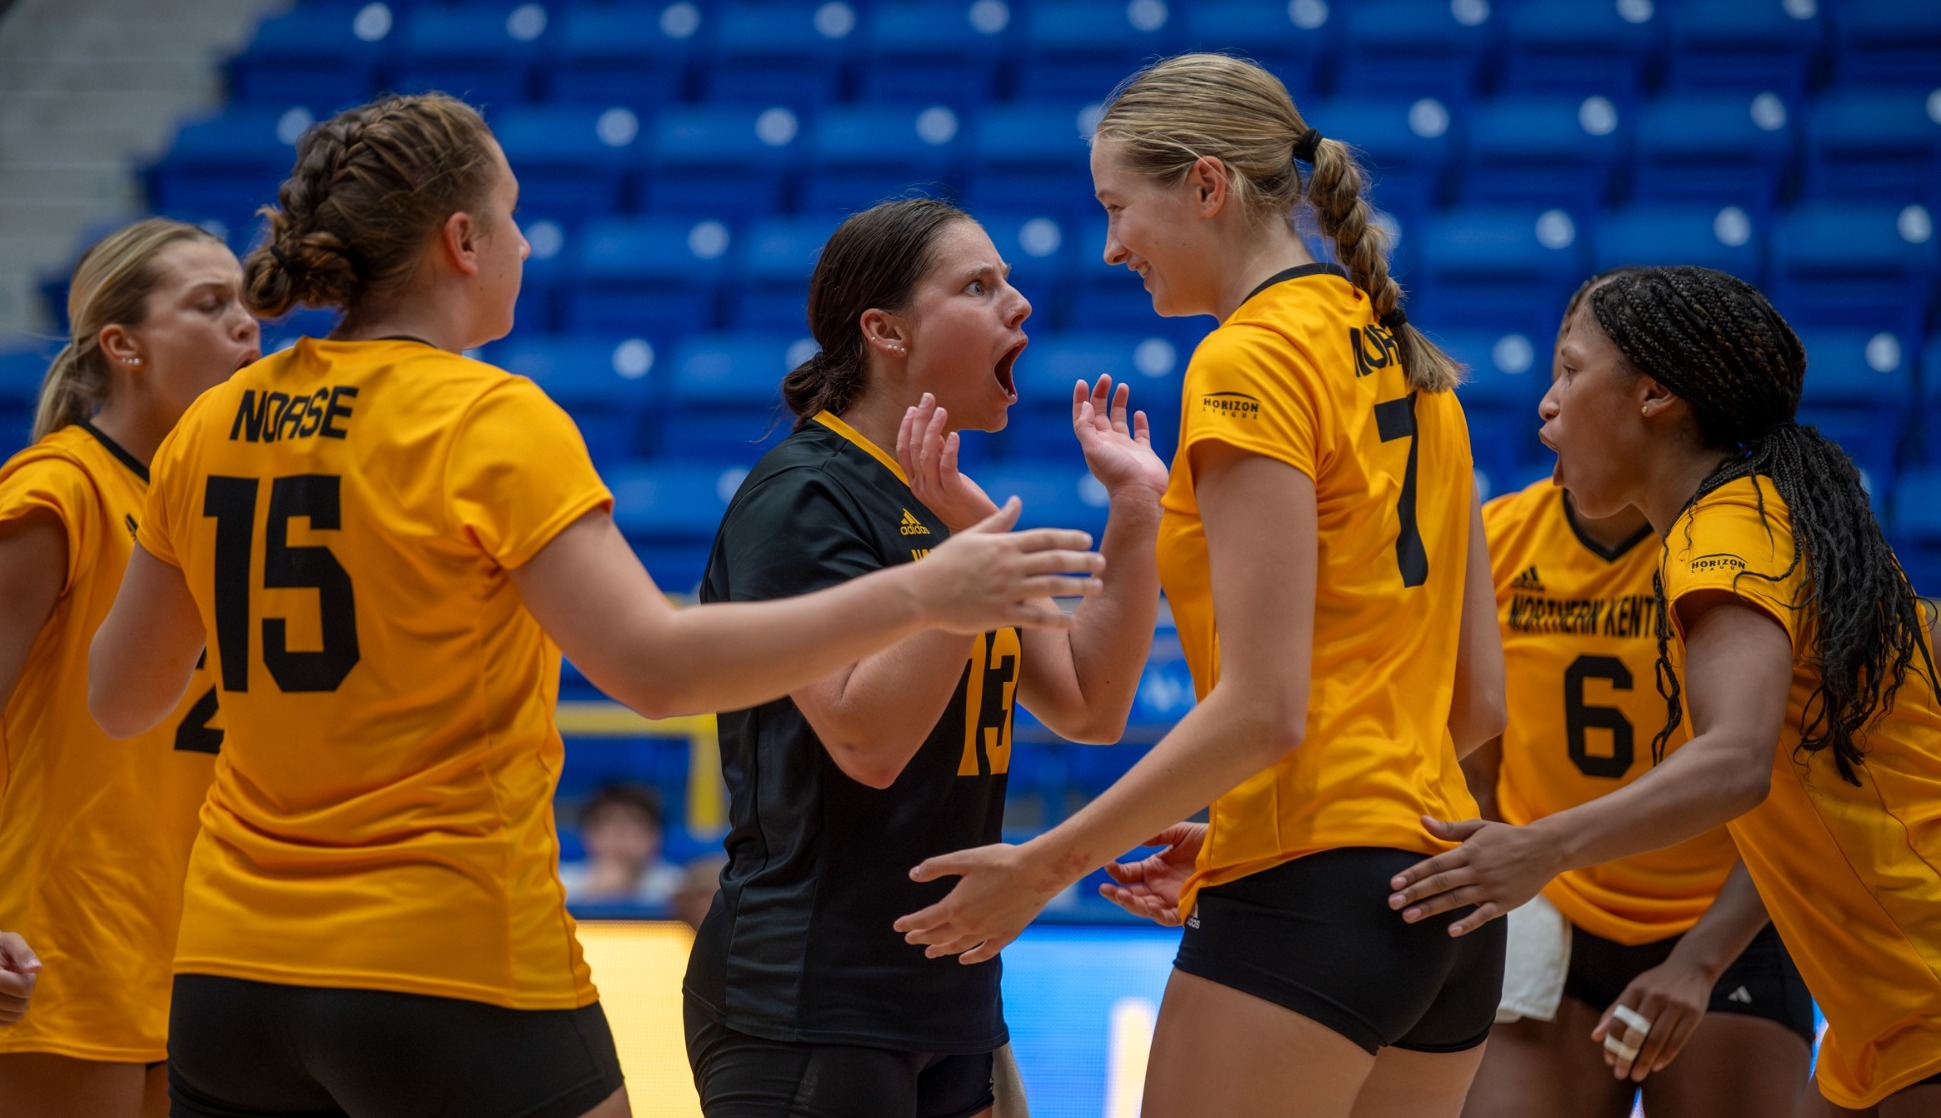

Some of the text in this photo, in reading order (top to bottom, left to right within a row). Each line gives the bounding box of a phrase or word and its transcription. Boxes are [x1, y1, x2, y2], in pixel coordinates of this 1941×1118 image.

[1350, 324, 1402, 378] NOR
[230, 386, 360, 443] NORSE
[1203, 398, 1259, 412] HORIZON
[1374, 391, 1429, 588] 7
[900, 524, 931, 536] adidas
[203, 474, 361, 693] 15
[1691, 559, 1746, 570] HORIZON
[1691, 565, 1736, 574] LEAGU
[1510, 595, 1603, 635] NORTHERN
[957, 626, 1021, 776] 13
[1565, 655, 1634, 779] 6
